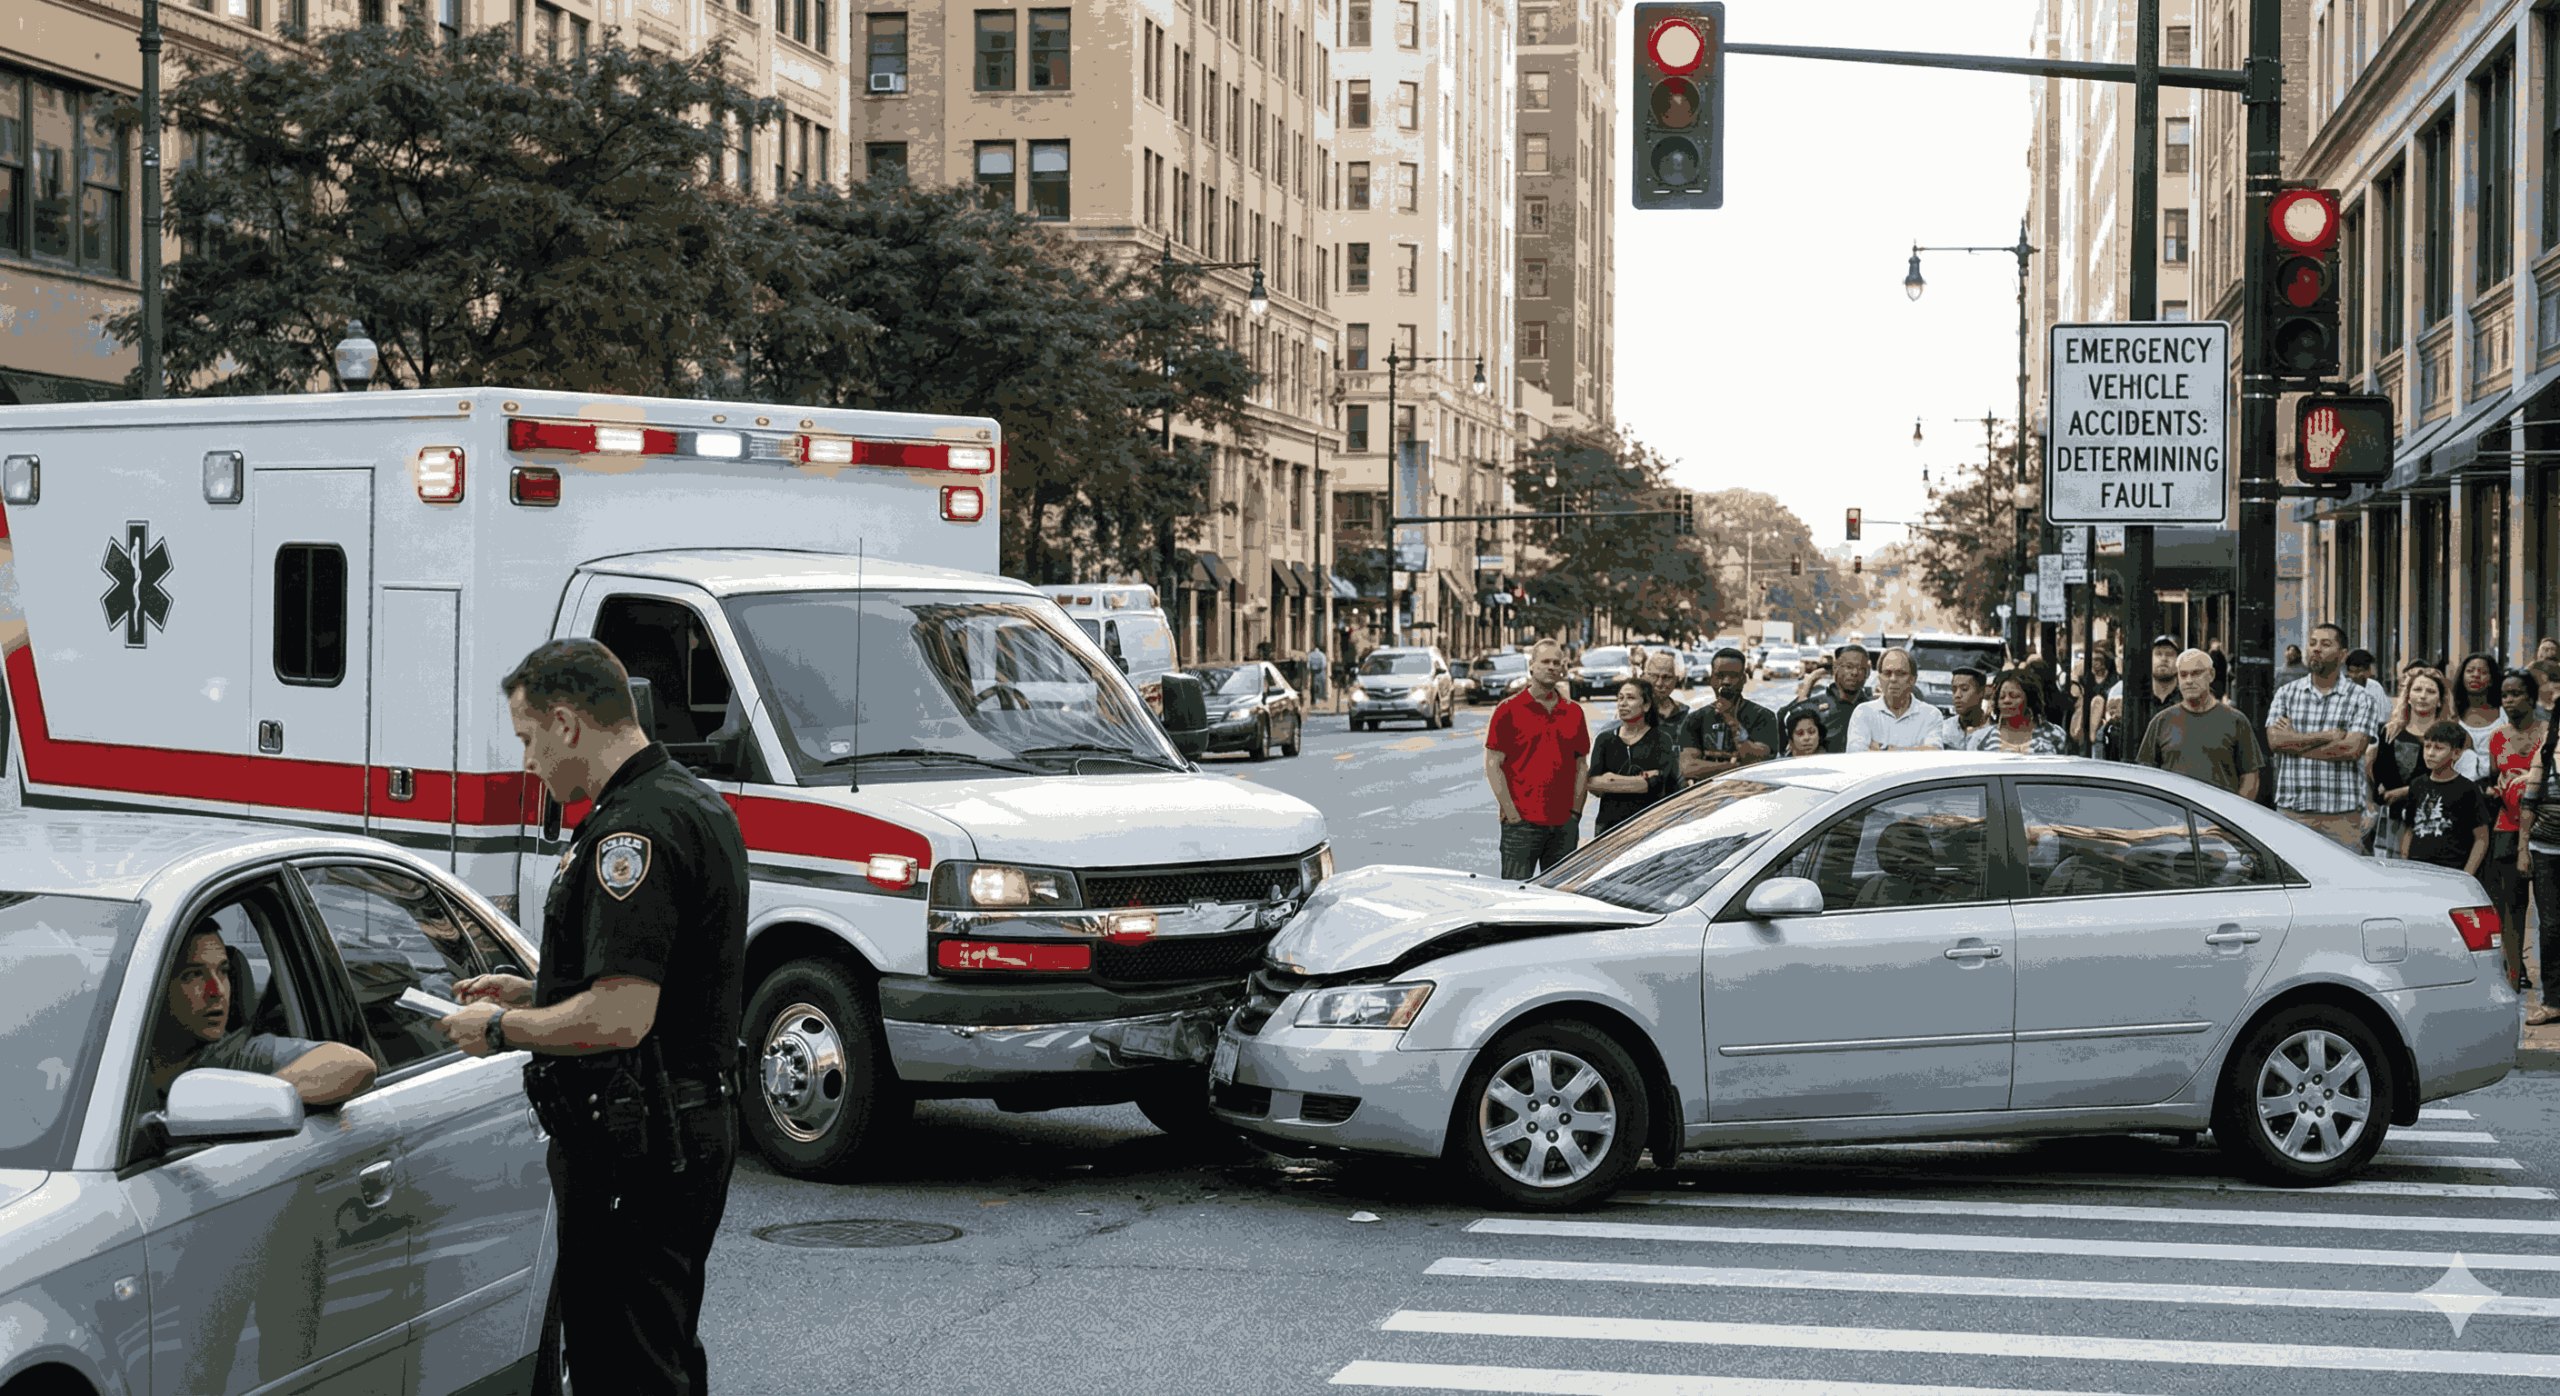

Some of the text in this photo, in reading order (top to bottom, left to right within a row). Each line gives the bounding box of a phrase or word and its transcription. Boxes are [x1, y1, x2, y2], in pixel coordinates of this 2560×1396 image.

[2066, 337, 2212, 363] EMERGENCY
[2088, 374, 2189, 399] VEHICLE
[2068, 410, 2207, 435] ACCIDENTS:
[2057, 447, 2218, 472] DETERMINING
[2101, 482, 2174, 508] FAULT
